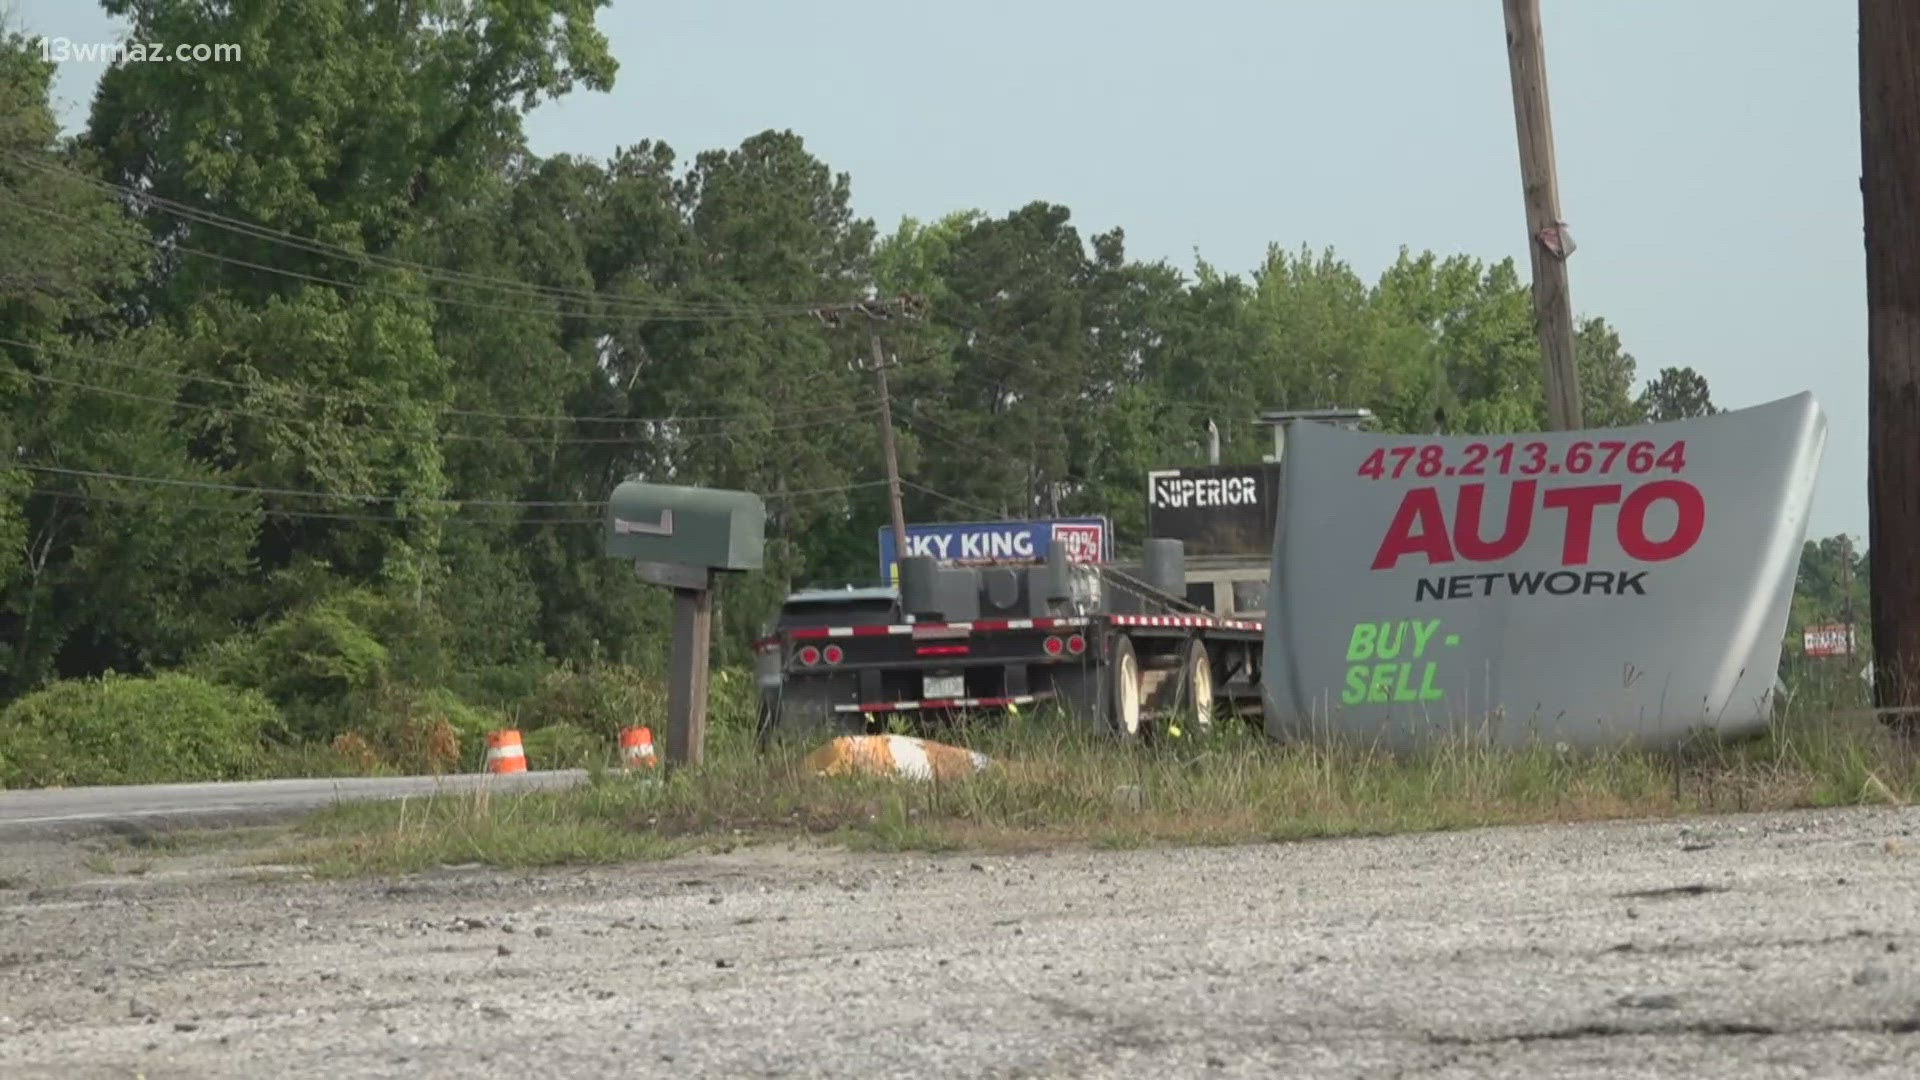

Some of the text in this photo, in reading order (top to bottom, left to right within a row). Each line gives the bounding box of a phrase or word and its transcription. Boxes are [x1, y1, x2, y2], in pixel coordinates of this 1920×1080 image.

[1357, 440, 1687, 480] 478.213.6764
[1157, 477, 1257, 508] SUPERIOR
[1370, 479, 1706, 571] AUTO
[961, 531, 1034, 558] KING
[1057, 530, 1097, 556] 50%
[1415, 570, 1649, 602] NETWORK
[1341, 661, 1444, 705] SELL
